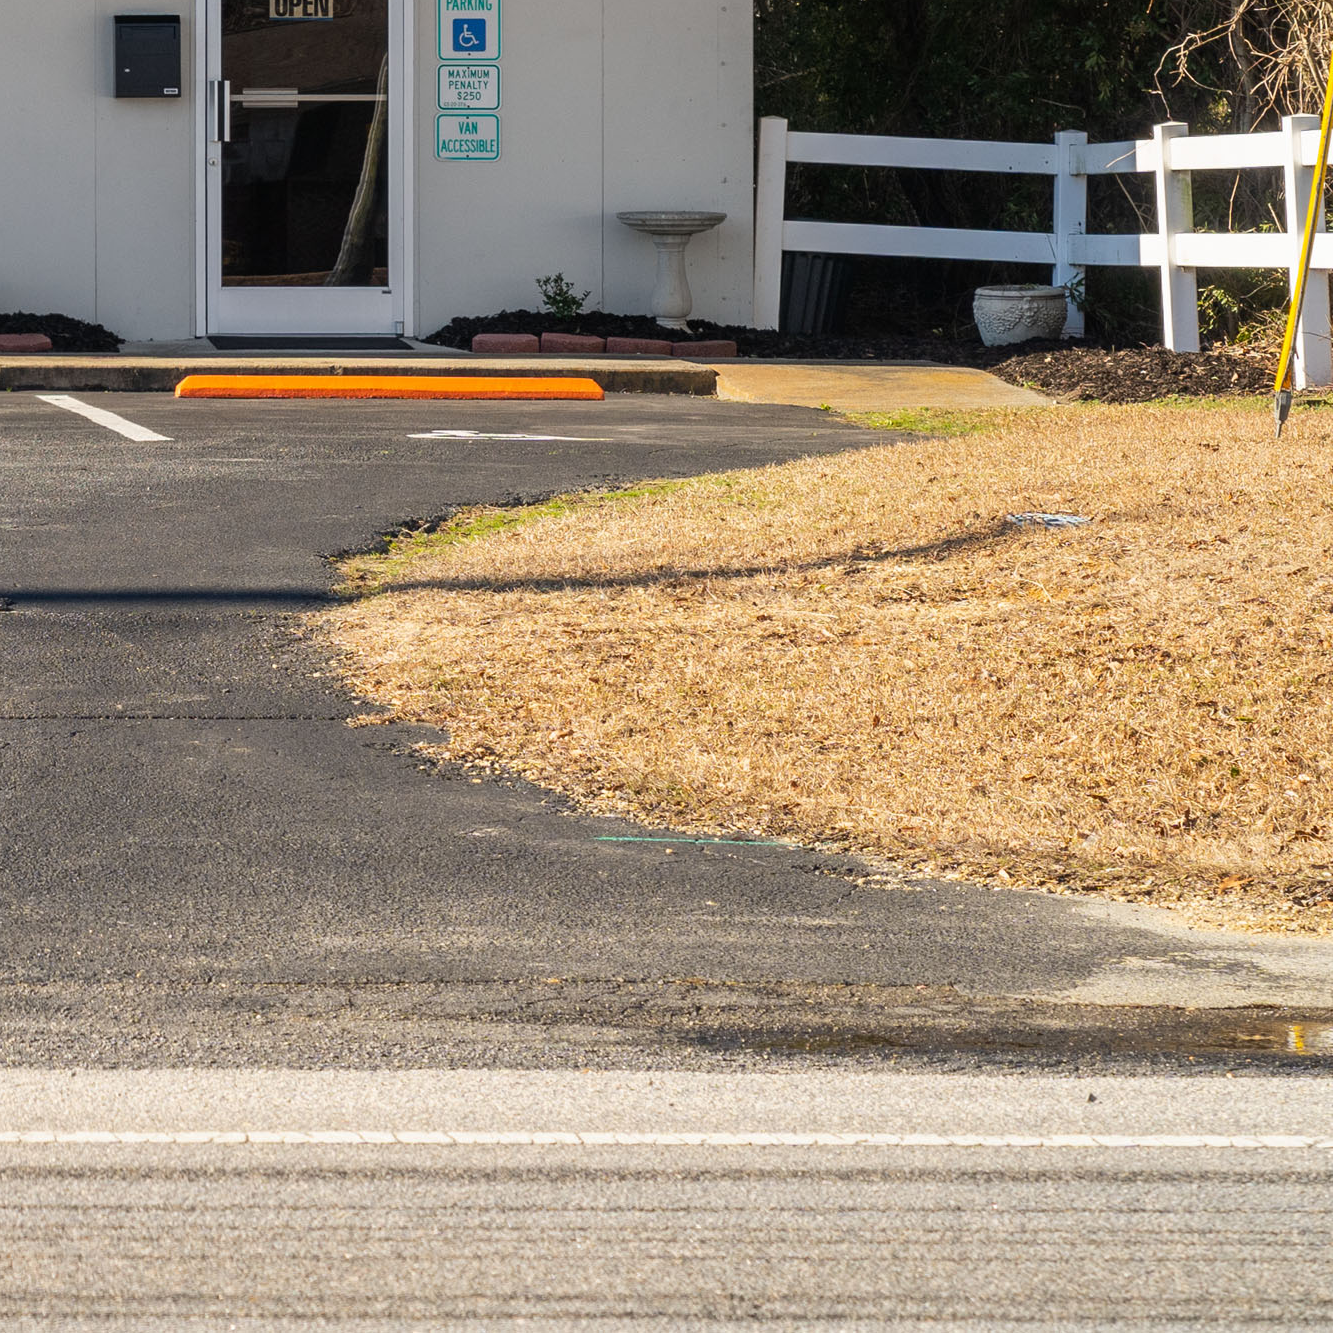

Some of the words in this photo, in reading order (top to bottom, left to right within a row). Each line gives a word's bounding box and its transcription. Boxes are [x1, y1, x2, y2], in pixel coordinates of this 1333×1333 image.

[447, 69, 491, 79] MAXIMUM
[448, 80, 489, 90] PENALTY
[457, 91, 482, 101] $250
[458, 121, 478, 135] VAN
[440, 138, 496, 153] ACCESSIBLE
